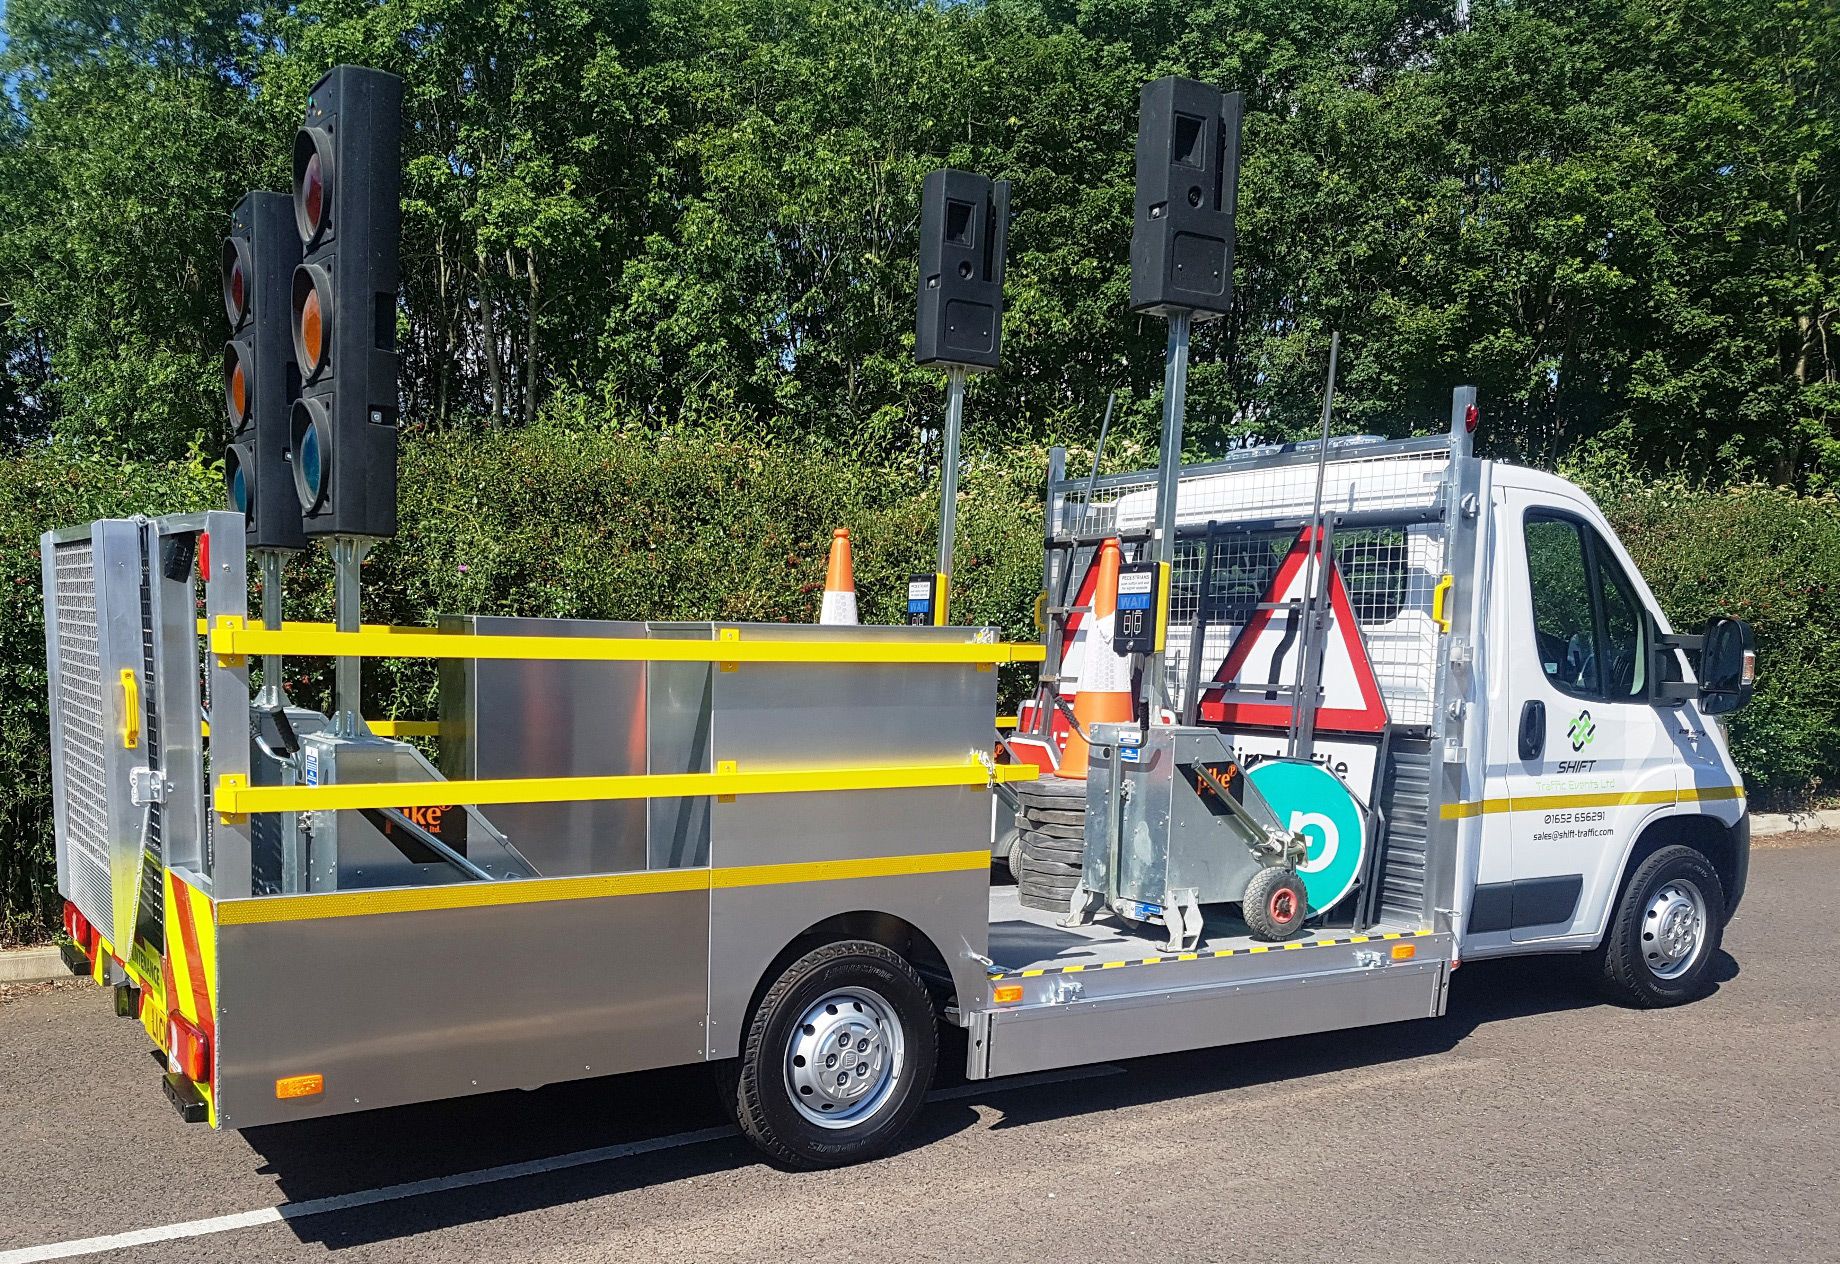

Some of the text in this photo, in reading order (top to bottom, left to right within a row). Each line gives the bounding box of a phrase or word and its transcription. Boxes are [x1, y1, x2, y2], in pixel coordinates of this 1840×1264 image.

[1120, 596, 1148, 609] WAIT
[1557, 760, 1597, 774] SHIFT
[1536, 779, 1615, 791] Traffic Events Ltd
[1544, 811, 1605, 824] 01652 656291
[1533, 828, 1614, 842] sales@shift-traffic.com
